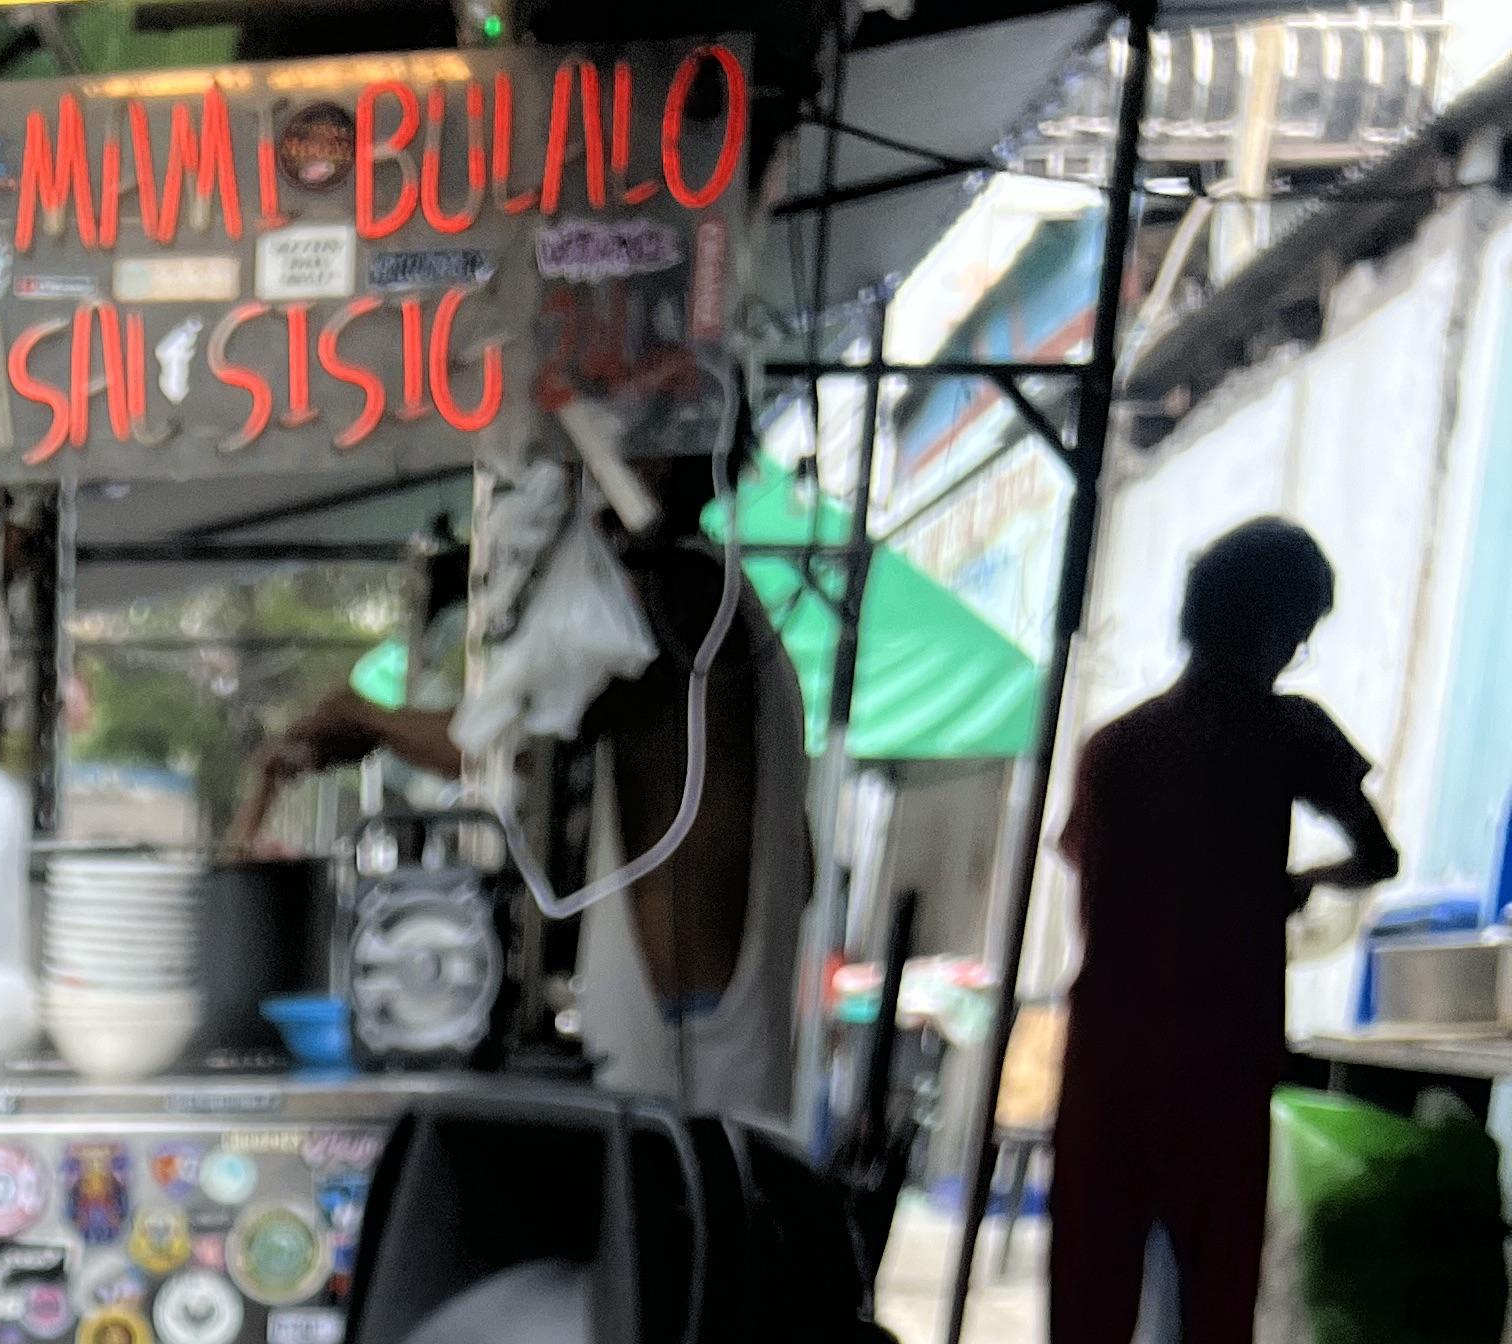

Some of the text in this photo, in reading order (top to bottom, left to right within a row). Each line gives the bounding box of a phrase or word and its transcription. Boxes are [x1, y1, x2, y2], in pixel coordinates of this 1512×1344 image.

[15, 81, 292, 252] MAMI
[355, 44, 747, 240] BULALO
[207, 287, 506, 453] SISIG
